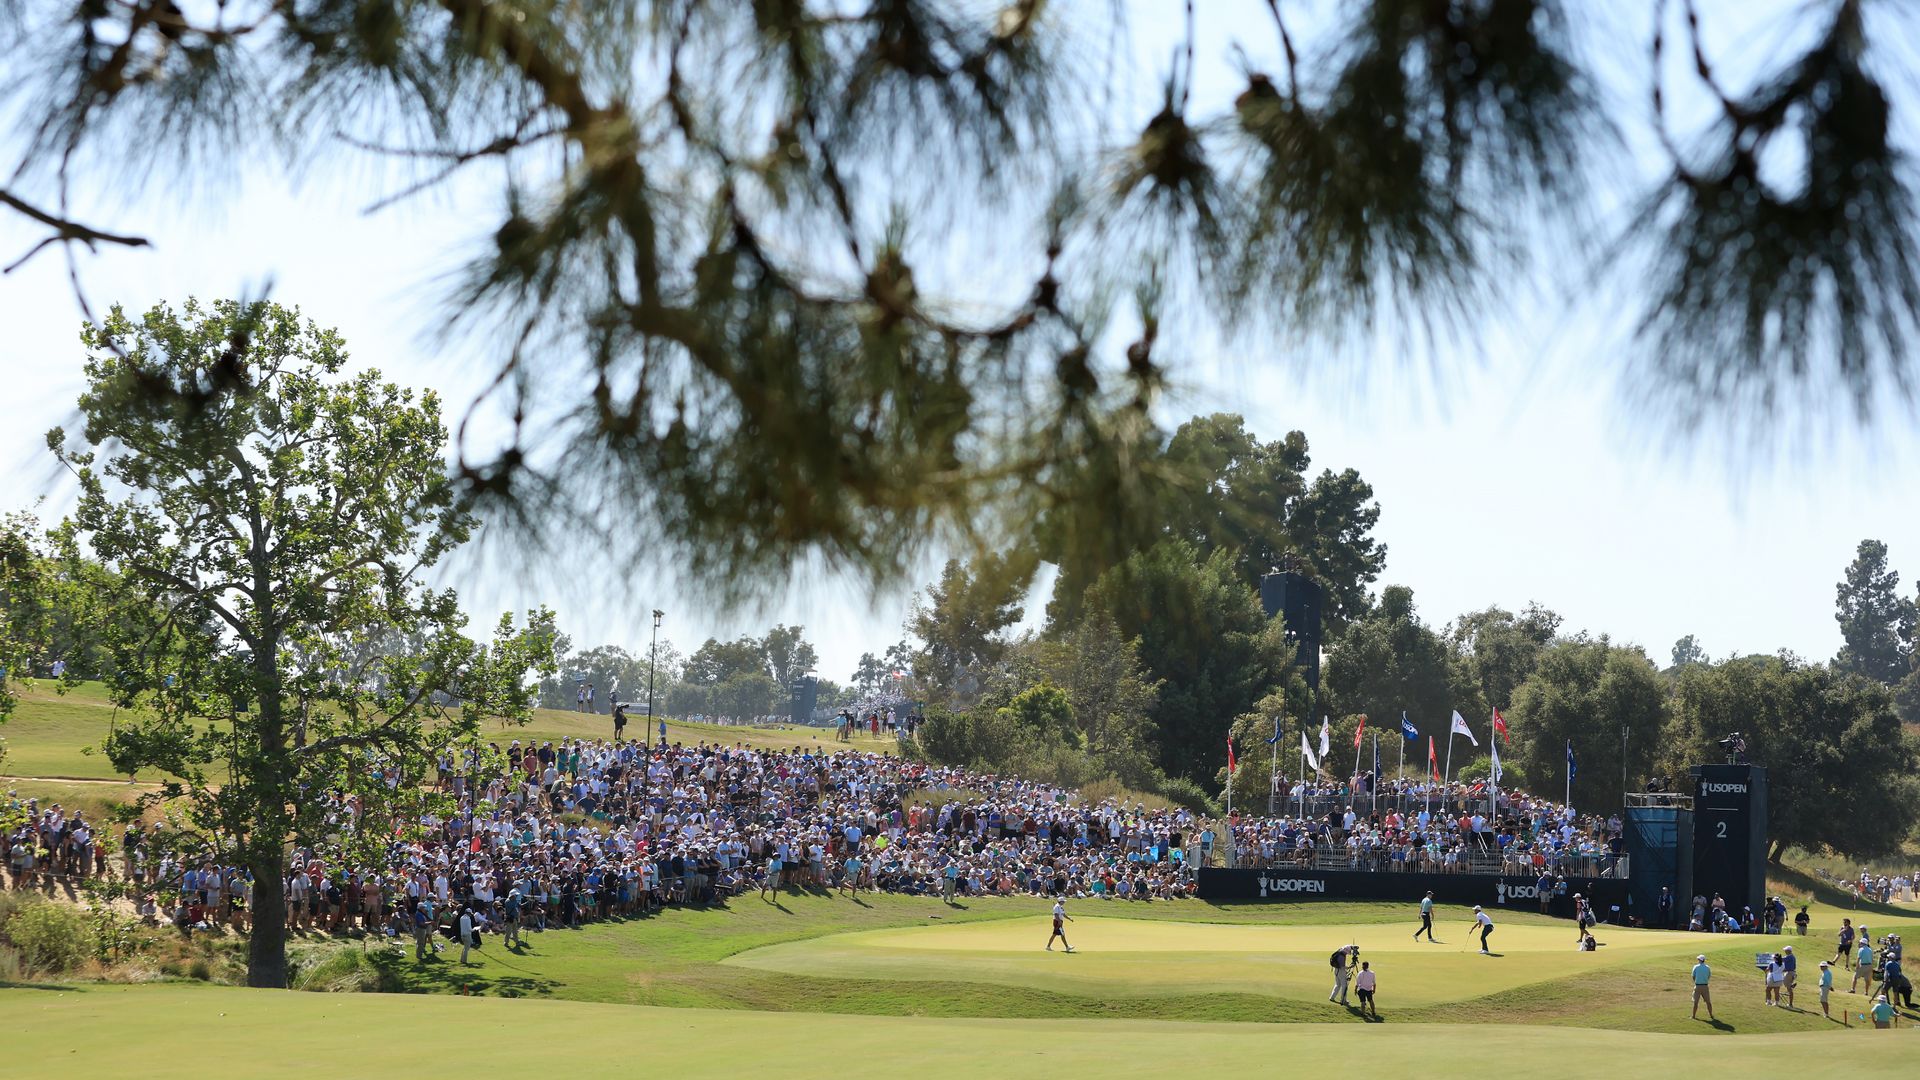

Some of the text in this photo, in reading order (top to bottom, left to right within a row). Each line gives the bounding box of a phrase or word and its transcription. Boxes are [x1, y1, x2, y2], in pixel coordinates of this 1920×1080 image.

[1709, 783, 1747, 793] USOPEN
[1716, 821, 1727, 838] 2
[1269, 879, 1325, 892] USOPEN
